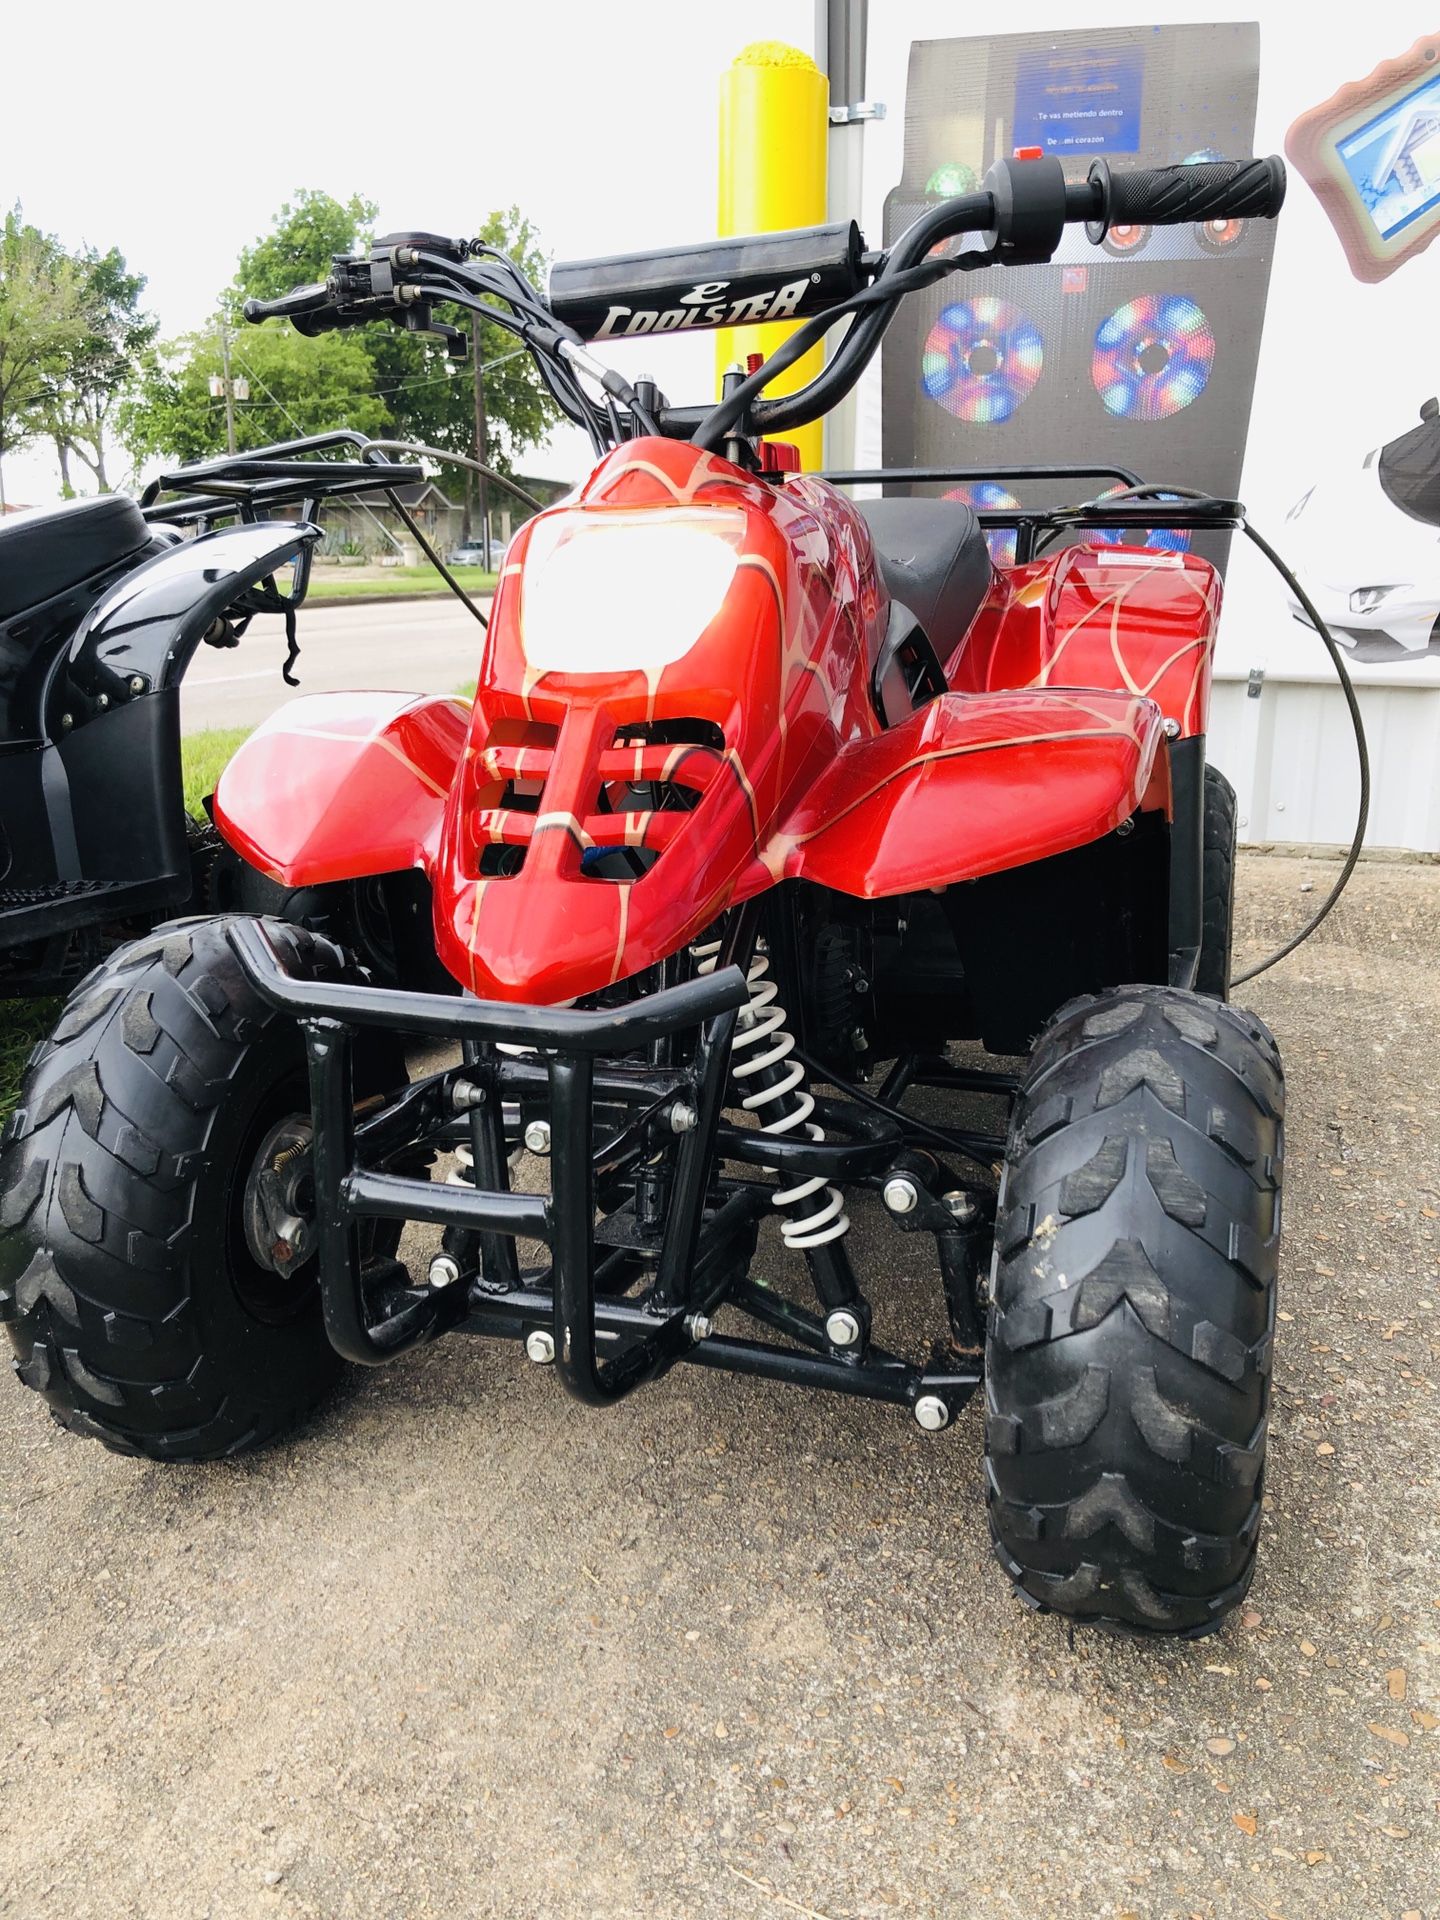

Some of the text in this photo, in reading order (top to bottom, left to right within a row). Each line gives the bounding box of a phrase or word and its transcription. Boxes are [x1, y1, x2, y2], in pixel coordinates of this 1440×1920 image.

[1062, 110, 1097, 119] metiendo
[1098, 109, 1123, 118] dentro
[1047, 137, 1058, 146] De
